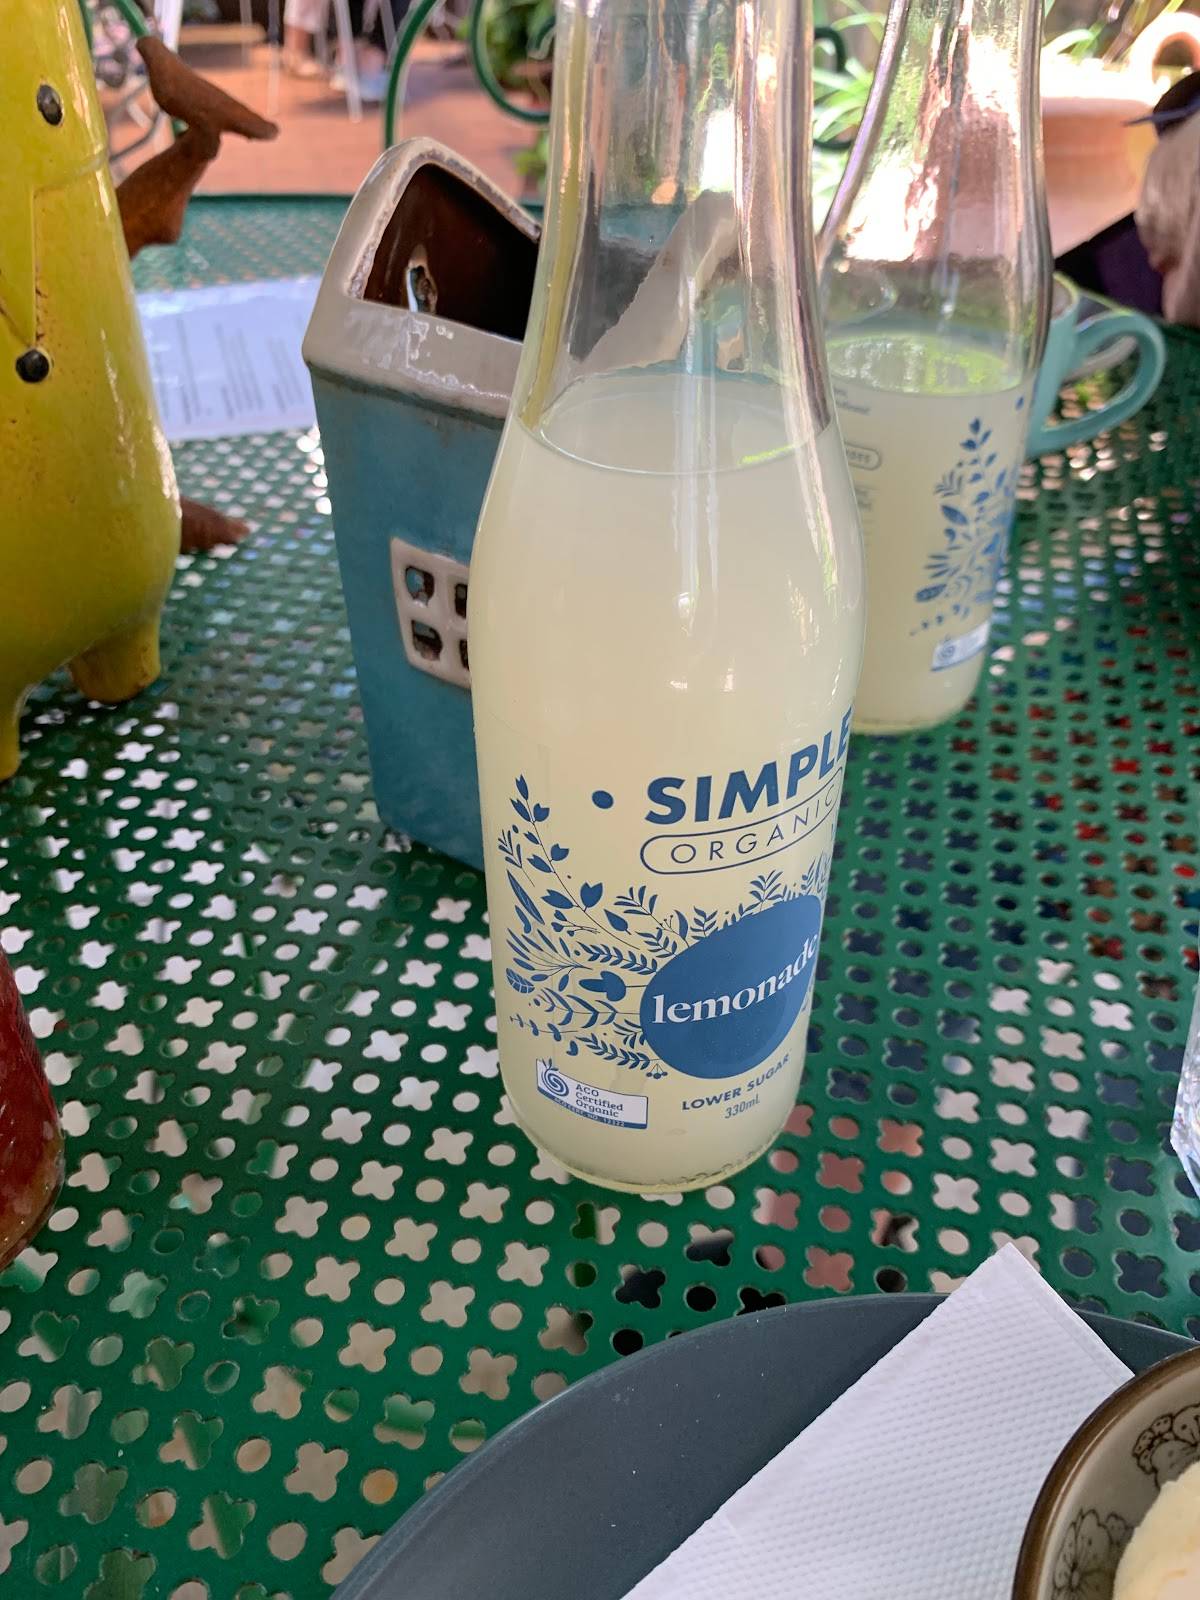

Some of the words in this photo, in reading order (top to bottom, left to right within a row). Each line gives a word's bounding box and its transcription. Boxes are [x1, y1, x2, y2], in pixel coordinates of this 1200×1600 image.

[644, 706, 852, 825] SIMPLE
[671, 783, 835, 864] ORGANIC
[575, 1083, 600, 1097] ACO
[682, 1087, 742, 1111] LOWER
[747, 1053, 790, 1092] SUGAR
[575, 1091, 624, 1112] Certified
[575, 1098, 619, 1118] Organic
[725, 1093, 761, 1119] 330mL
